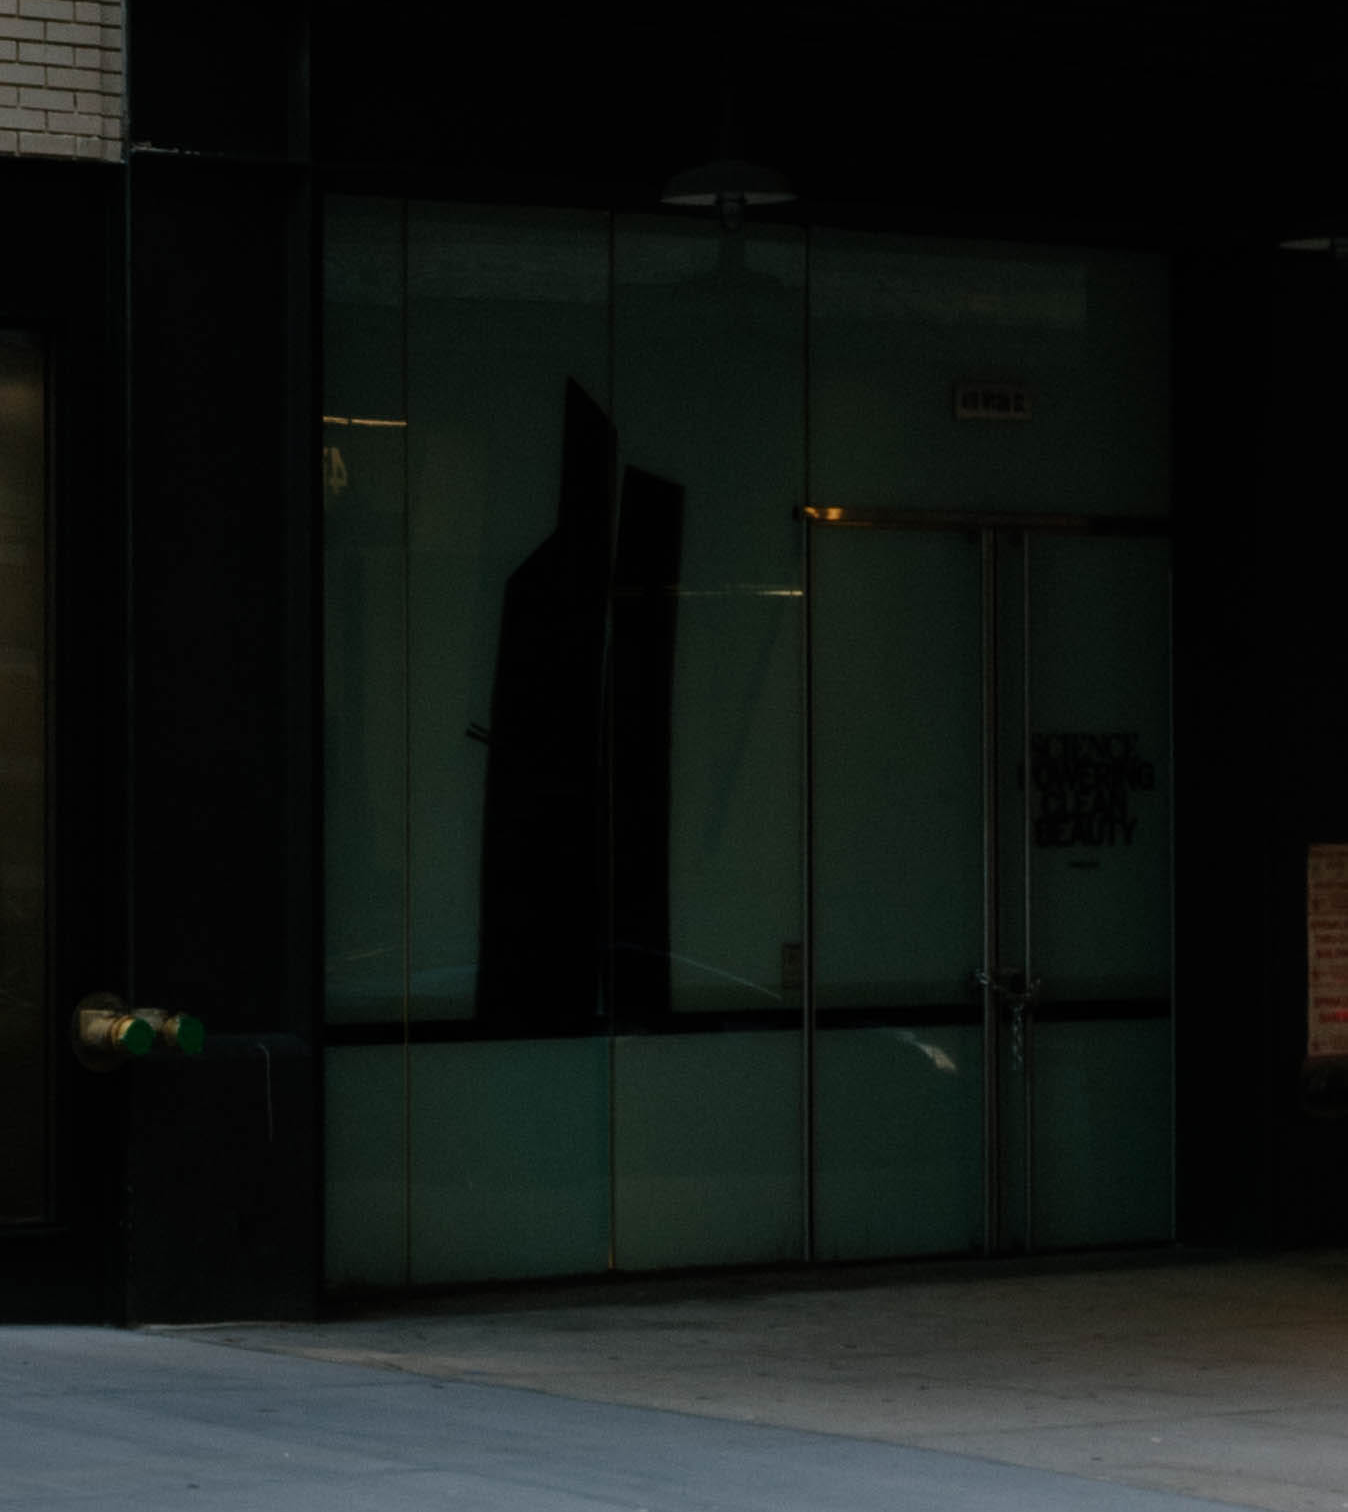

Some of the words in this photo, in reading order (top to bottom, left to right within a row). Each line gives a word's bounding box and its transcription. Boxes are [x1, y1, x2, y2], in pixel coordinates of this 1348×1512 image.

[1031, 732, 1139, 760] SCIENCE
[1041, 788, 1128, 818] CLEAN
[1034, 817, 1139, 848] BEAUTY
